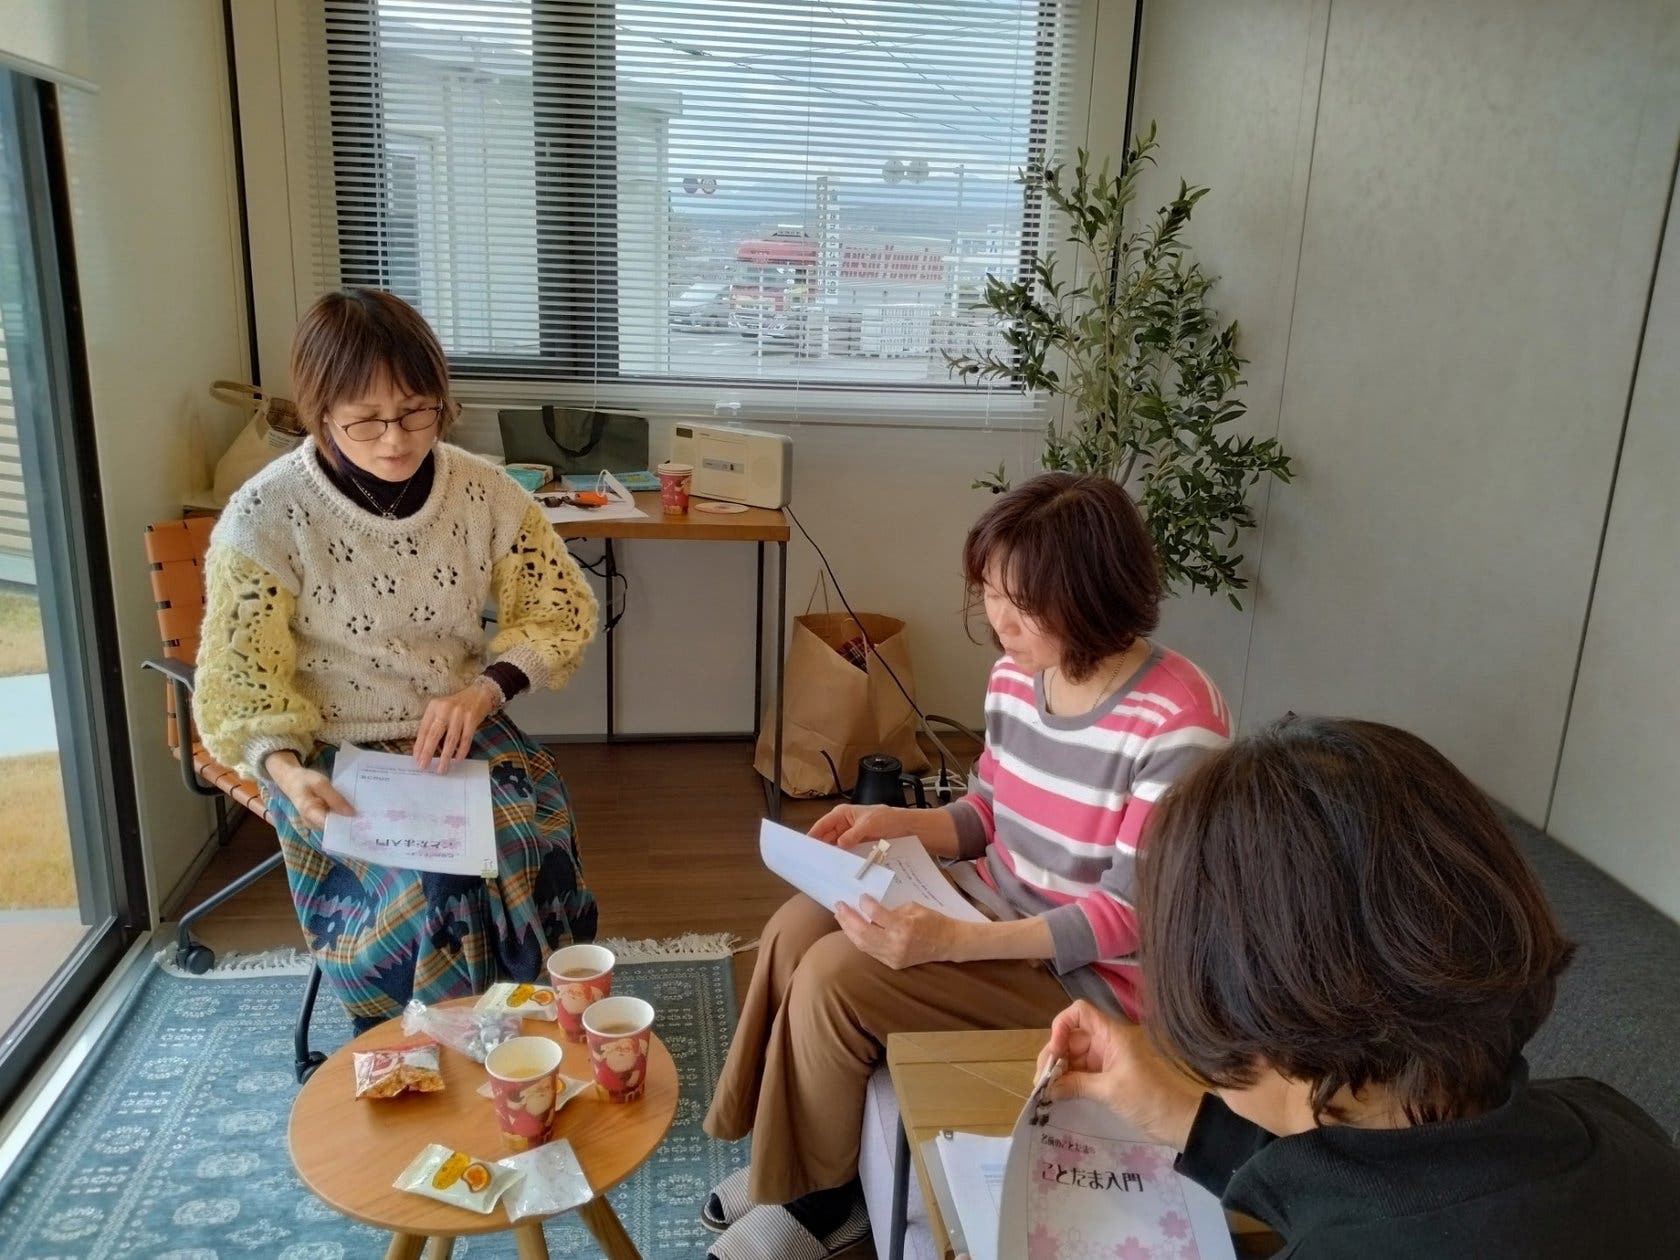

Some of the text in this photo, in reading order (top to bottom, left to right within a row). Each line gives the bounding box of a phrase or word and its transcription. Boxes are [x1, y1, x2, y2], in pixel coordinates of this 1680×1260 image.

[1041, 1161, 1144, 1192] ことだま入門
